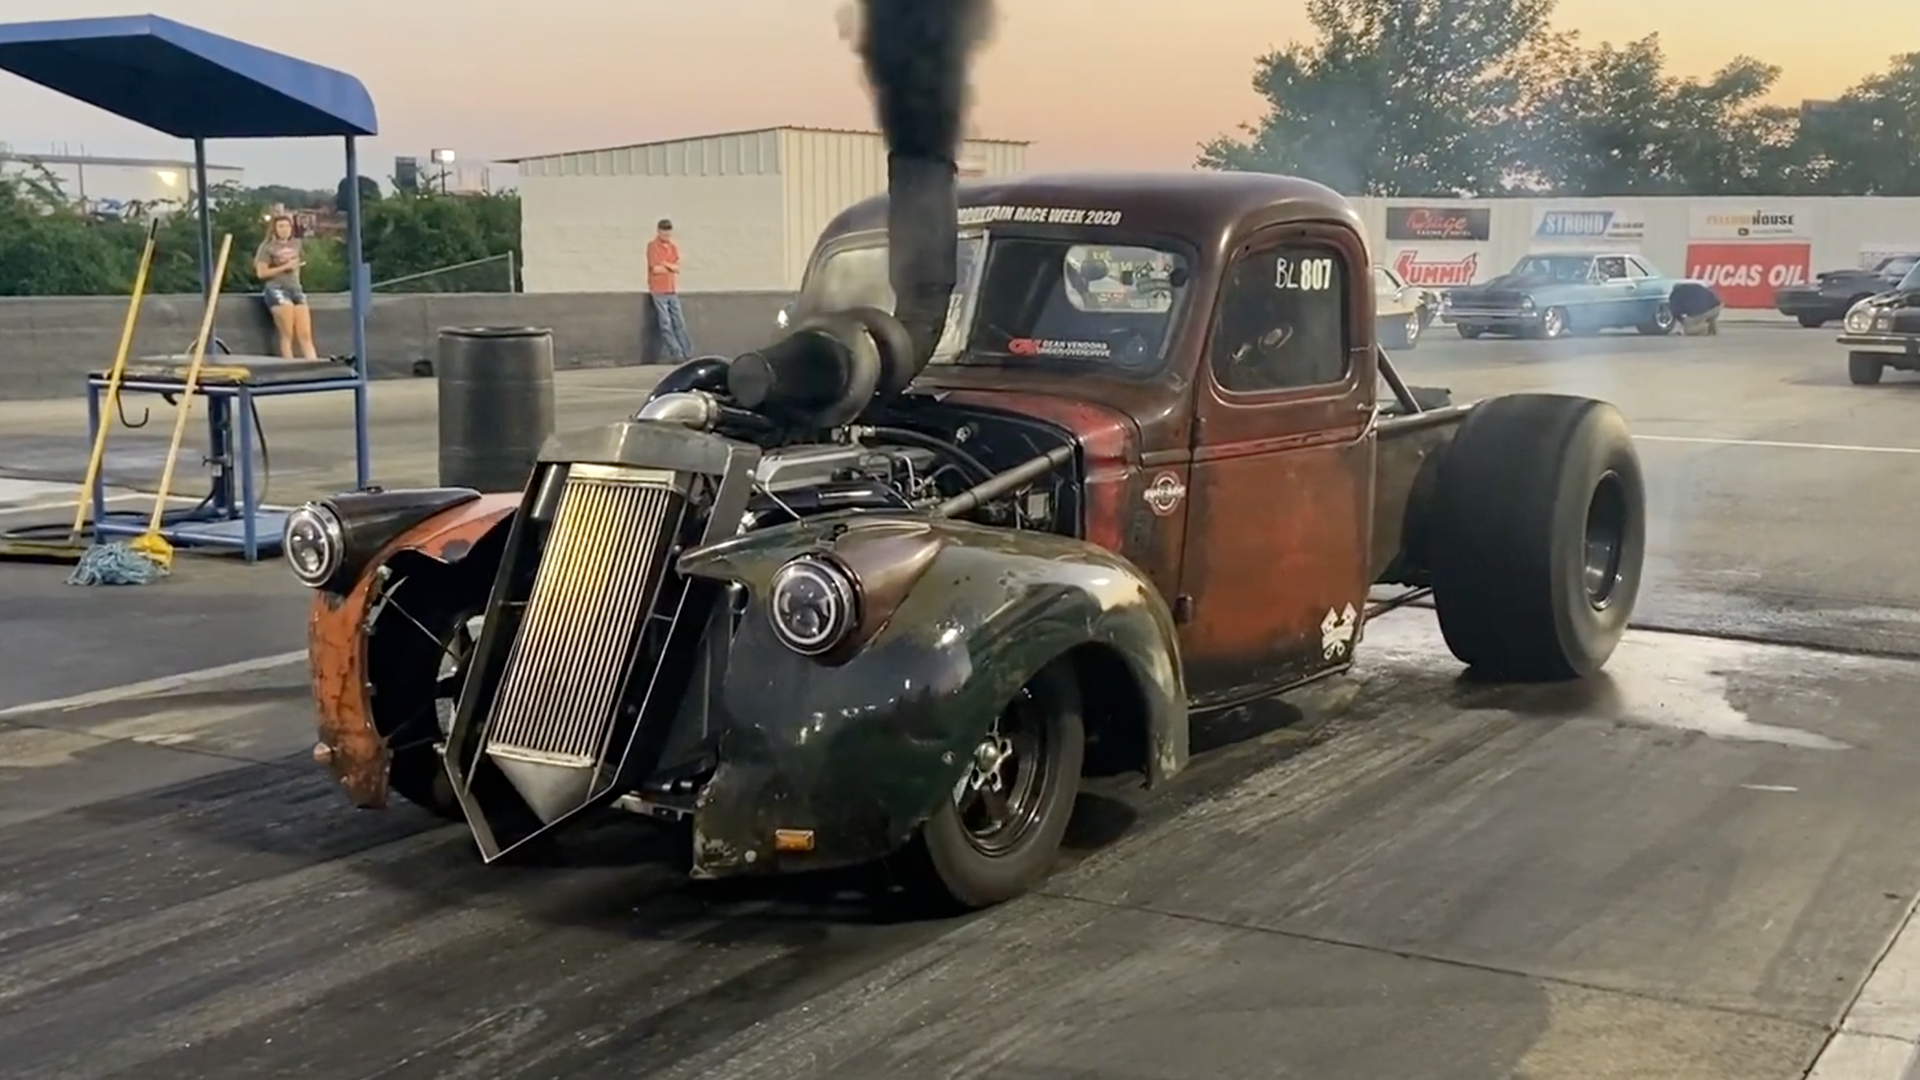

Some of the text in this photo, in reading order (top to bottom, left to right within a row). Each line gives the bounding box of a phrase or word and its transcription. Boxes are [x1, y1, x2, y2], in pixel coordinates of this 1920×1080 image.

[1014, 207, 1049, 222] RACE
[1048, 208, 1085, 225] WEEK
[1083, 211, 1122, 226] 2020
[1545, 213, 1605, 234] STROUD
[1300, 258, 1332, 290] 807
[1393, 250, 1477, 287] SUMMIT
[1691, 264, 1806, 287] LUCAS OIL
